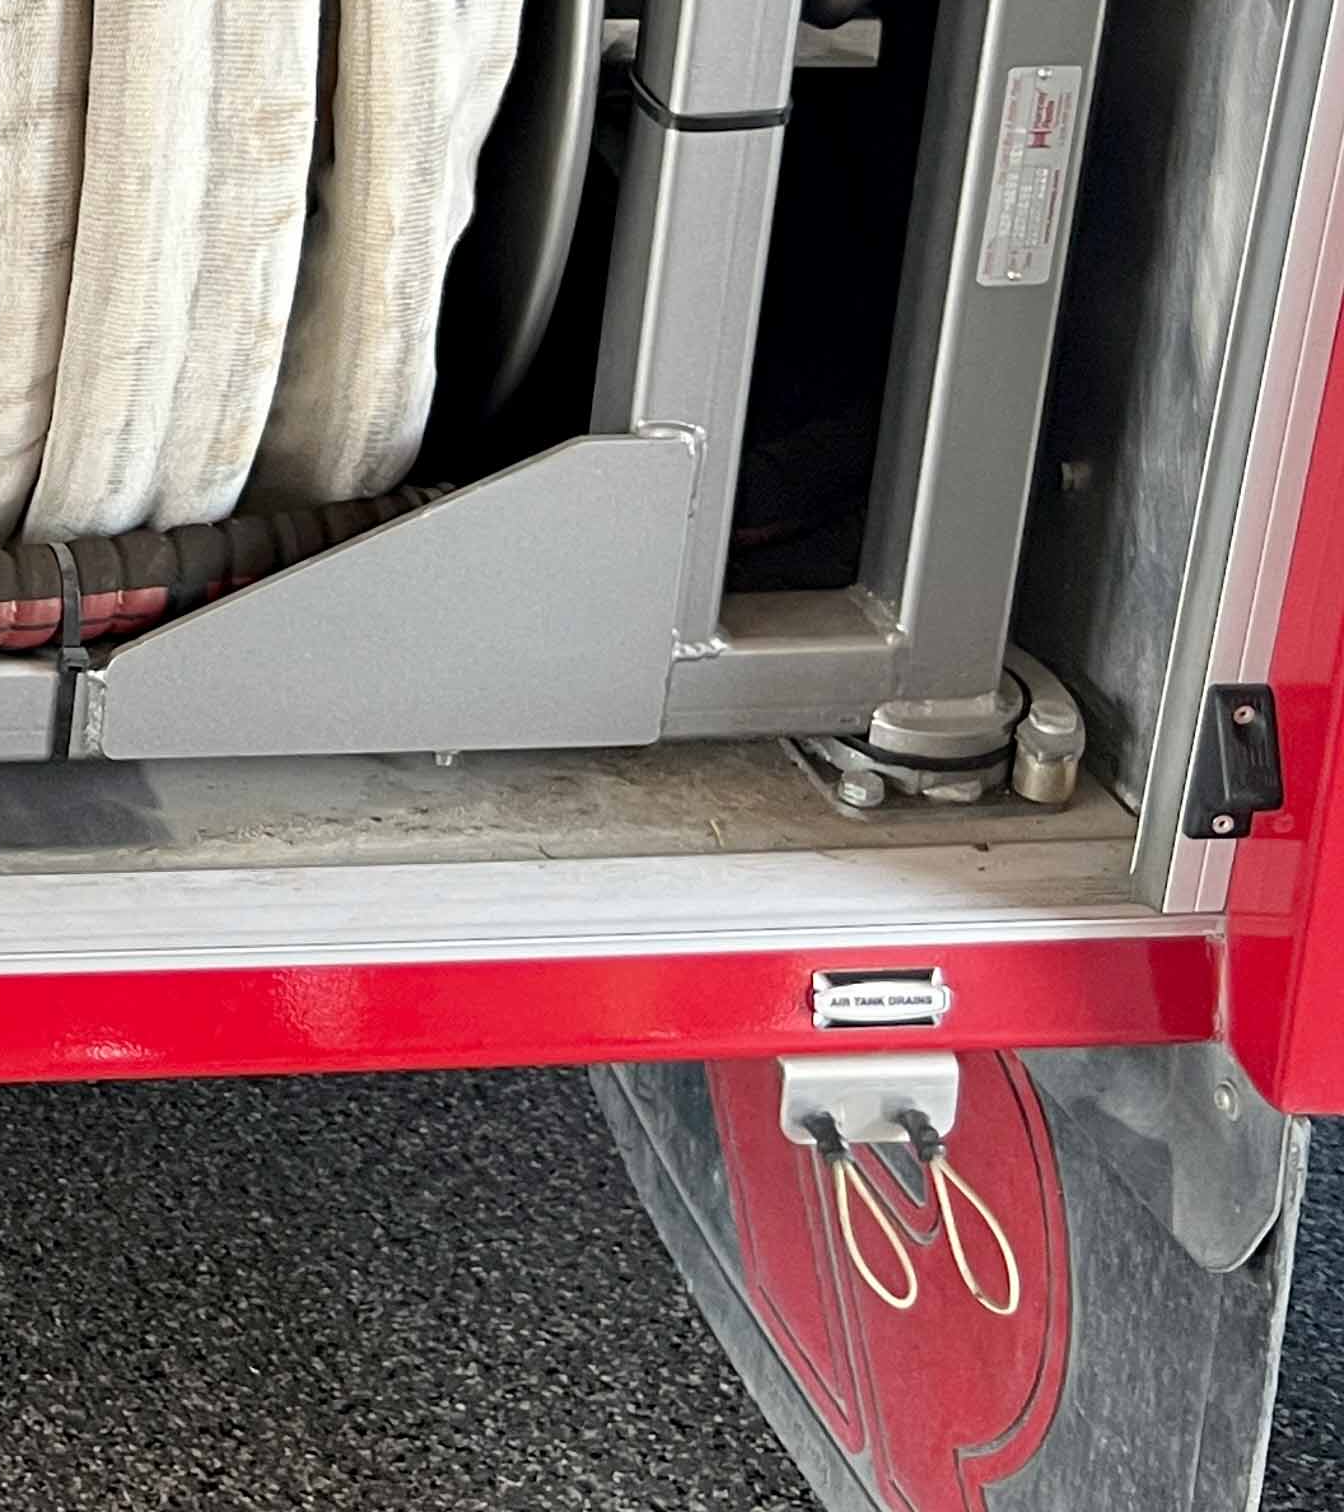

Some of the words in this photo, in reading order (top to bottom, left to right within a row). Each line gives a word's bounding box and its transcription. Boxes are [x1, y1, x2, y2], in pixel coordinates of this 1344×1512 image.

[830, 997, 851, 1007] AIR
[854, 996, 885, 1007] TANK
[888, 995, 933, 1006] DRAINS
